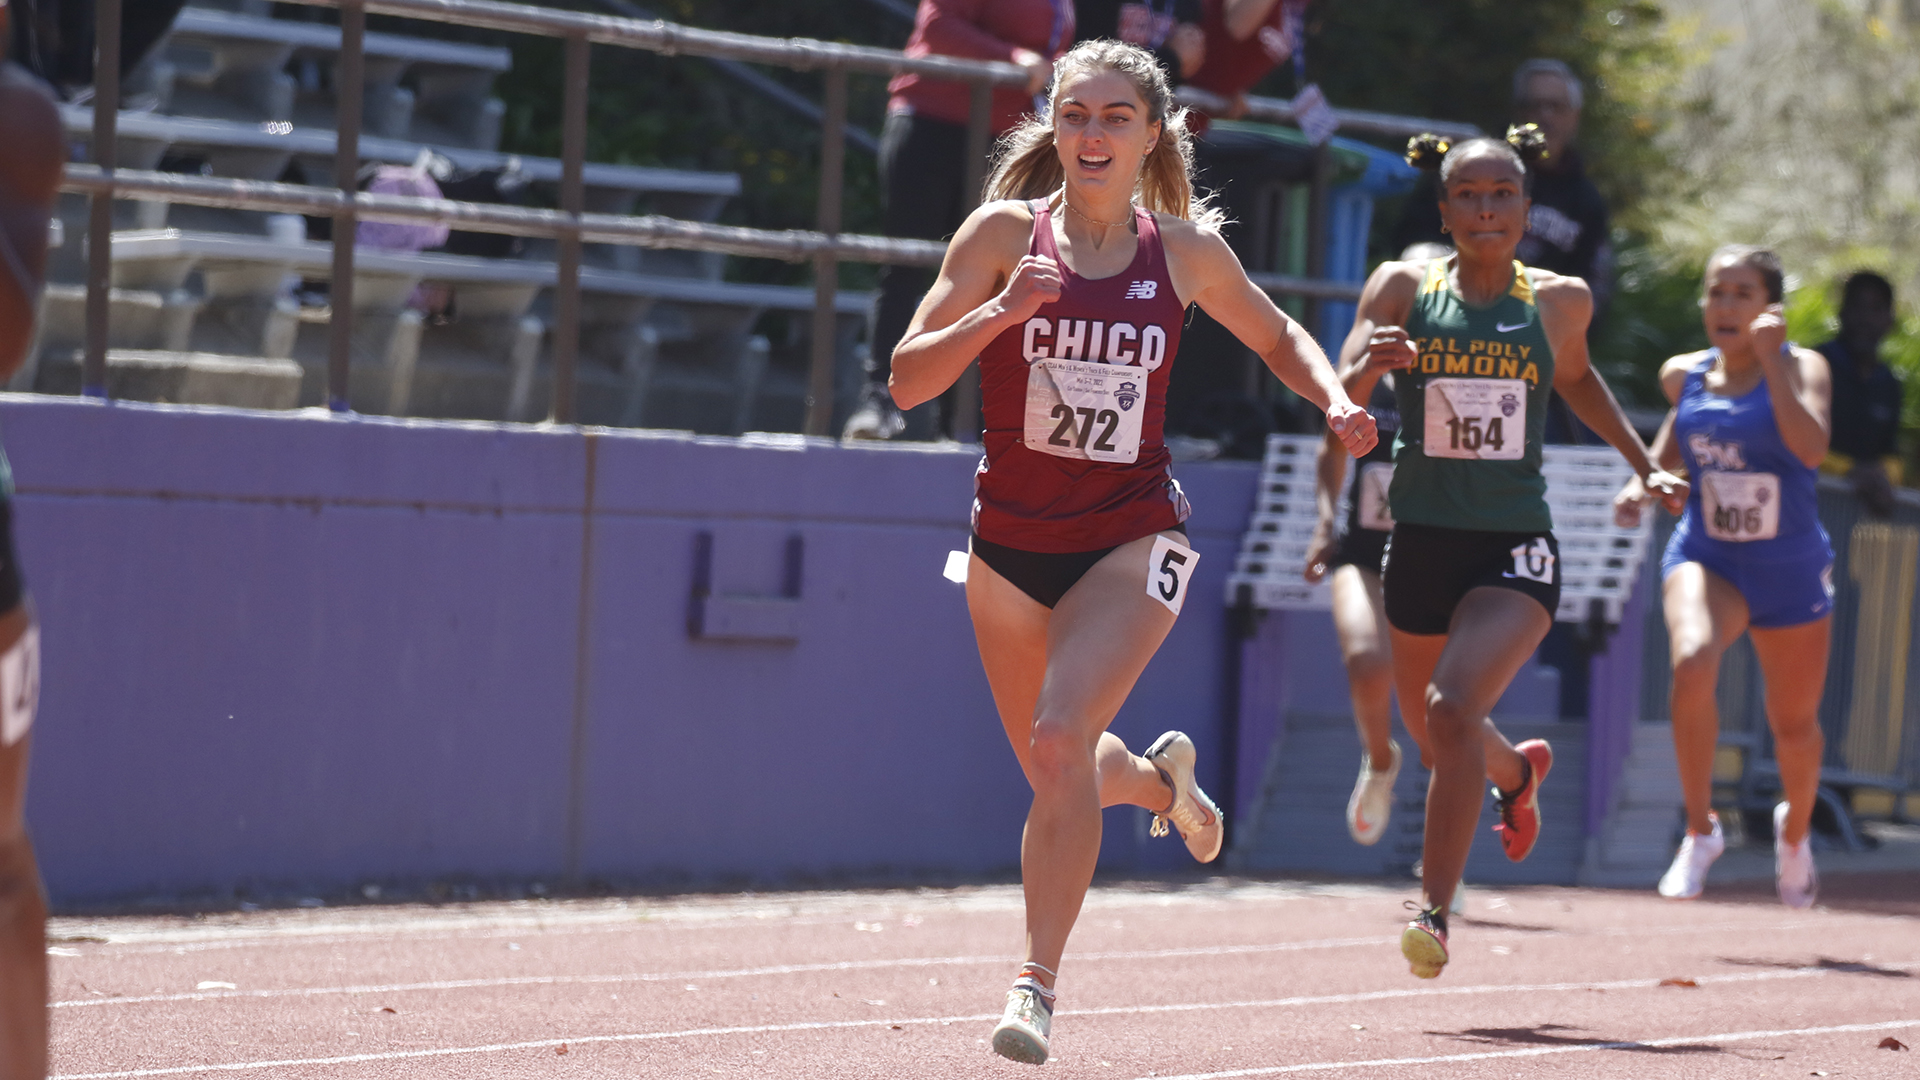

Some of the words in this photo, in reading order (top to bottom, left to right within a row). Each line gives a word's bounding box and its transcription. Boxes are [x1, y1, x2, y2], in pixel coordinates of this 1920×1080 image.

[1021, 316, 1167, 373] CHICO
[1415, 337, 1461, 353] CAL
[1469, 340, 1531, 360] POLY
[1048, 404, 1119, 452] 272
[1446, 417, 1504, 451] 154
[1158, 548, 1187, 602] 5
